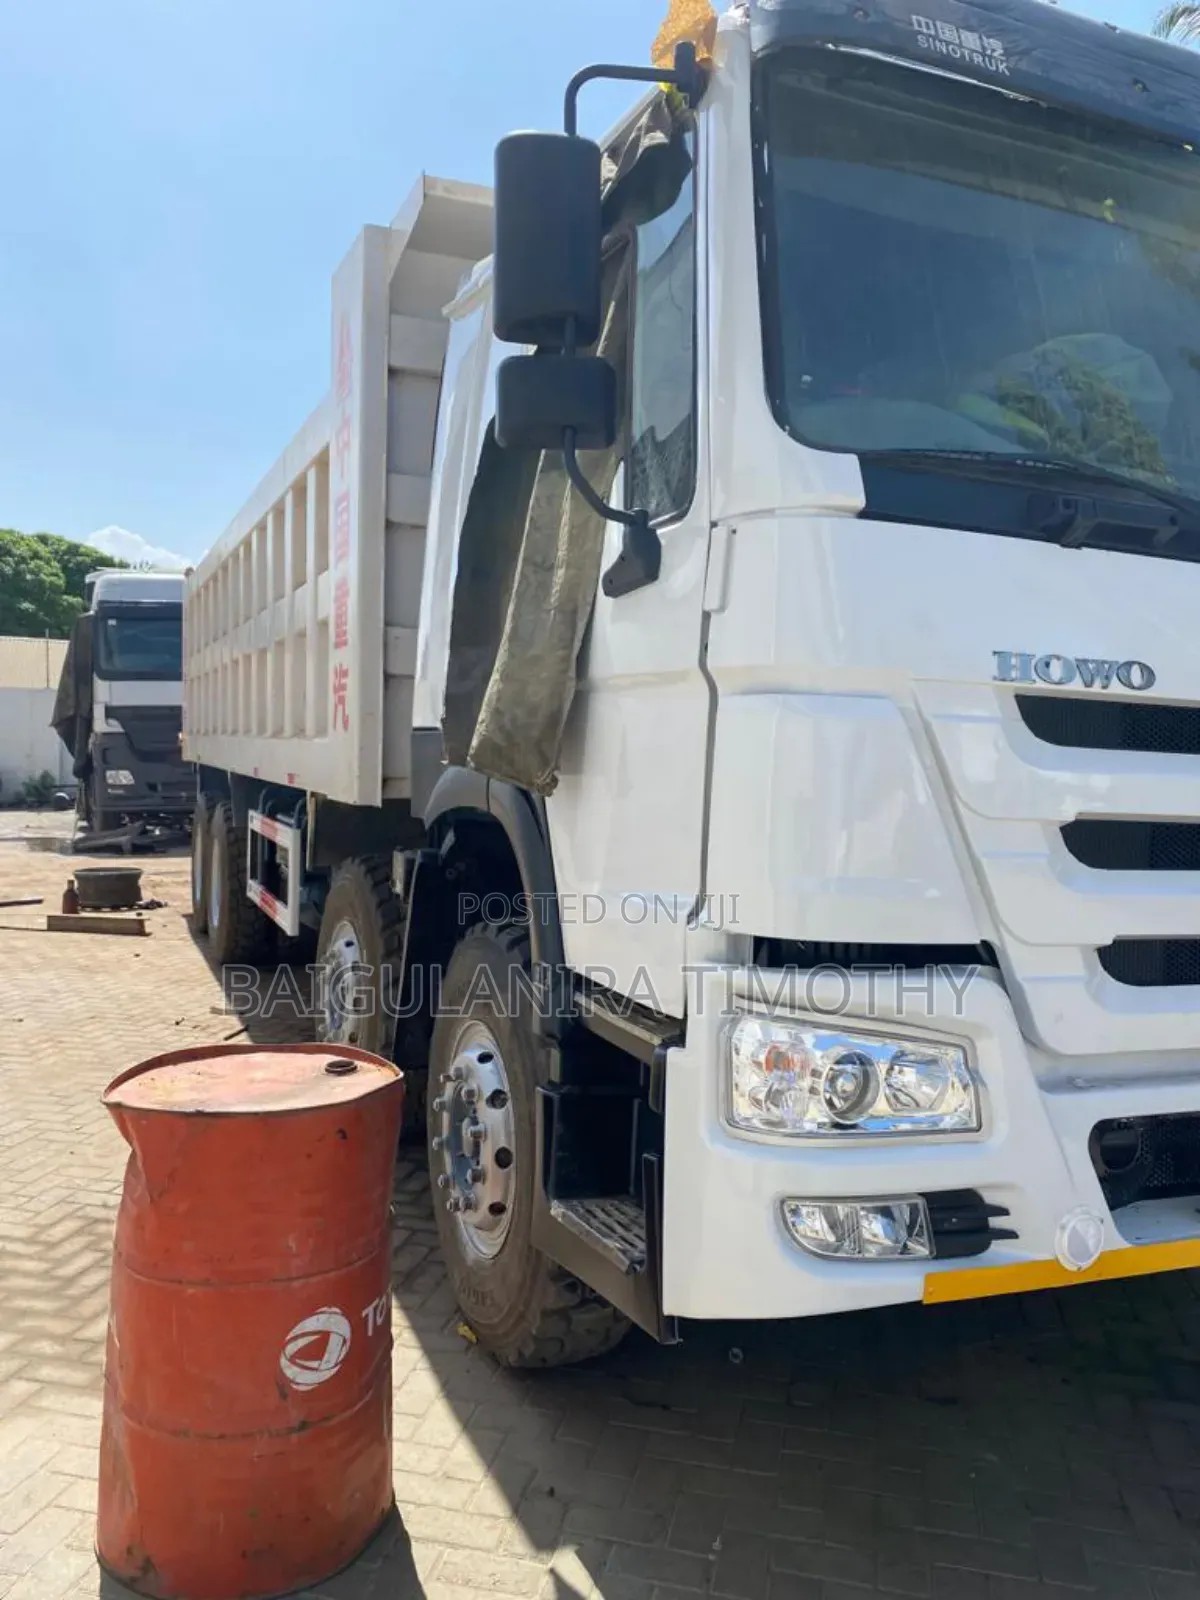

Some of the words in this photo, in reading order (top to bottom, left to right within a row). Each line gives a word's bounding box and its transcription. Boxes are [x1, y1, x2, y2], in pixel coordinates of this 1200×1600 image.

[916, 34, 1010, 76] SINOTRUK
[992, 650, 1156, 691] HOWO
[362, 1284, 392, 1336] TO
